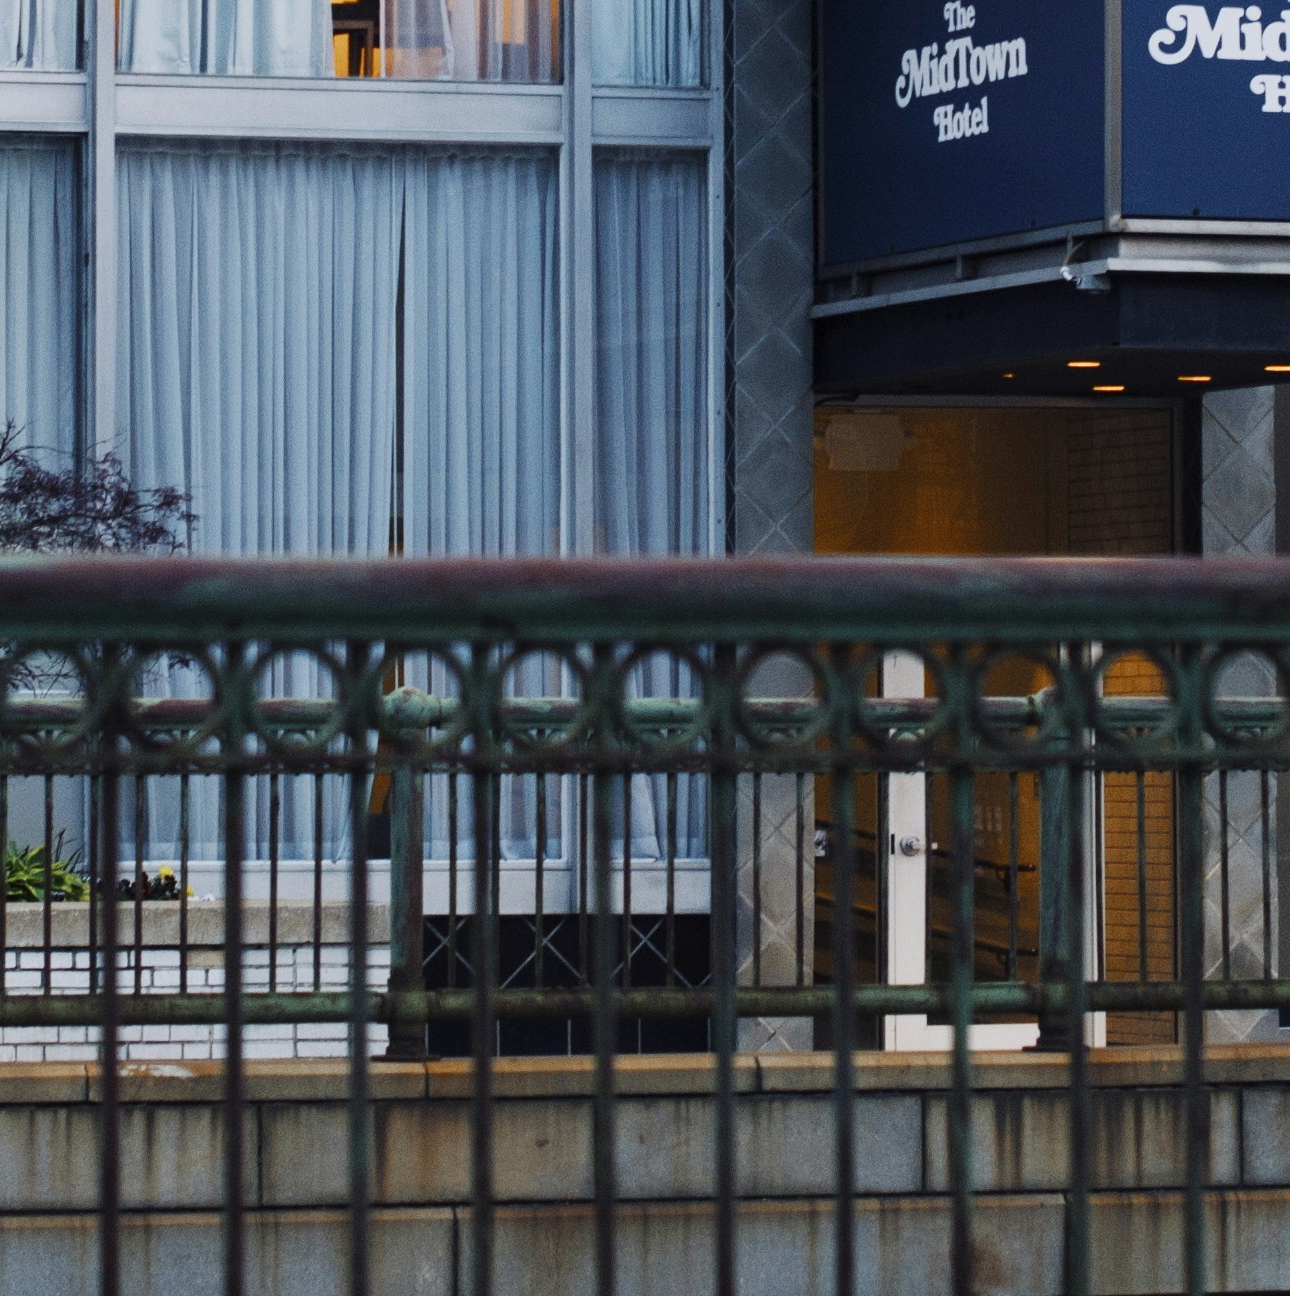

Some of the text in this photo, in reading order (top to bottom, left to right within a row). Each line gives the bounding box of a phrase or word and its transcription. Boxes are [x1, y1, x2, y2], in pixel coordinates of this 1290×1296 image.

[943, 0, 976, 32] The
[895, 36, 1028, 108] MidTown
[933, 97, 989, 142] Hotel
